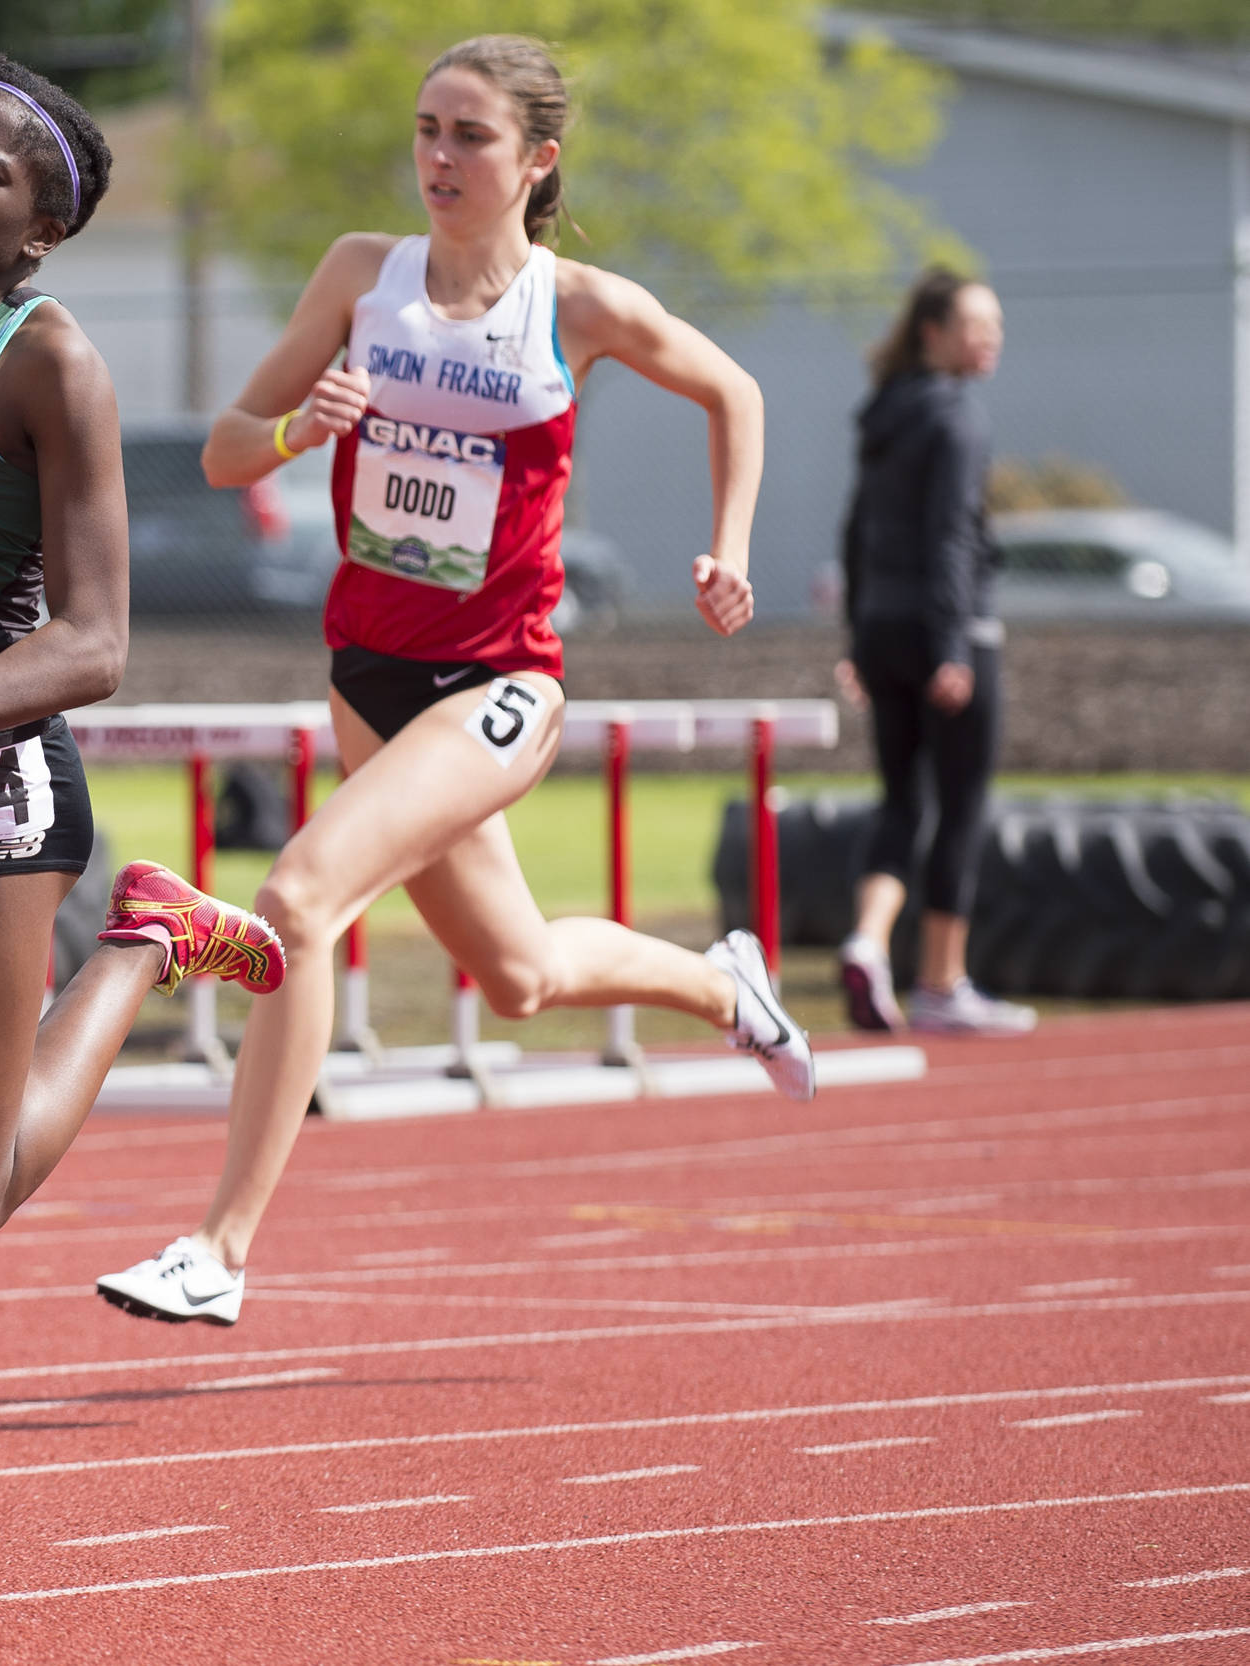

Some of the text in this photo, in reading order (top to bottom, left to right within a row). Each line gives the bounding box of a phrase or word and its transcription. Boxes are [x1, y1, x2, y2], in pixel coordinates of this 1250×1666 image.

[368, 344, 522, 405] SIMON FRASER
[367, 416, 496, 463] GNAC
[385, 474, 456, 521] DODD
[481, 685, 536, 747] 5
